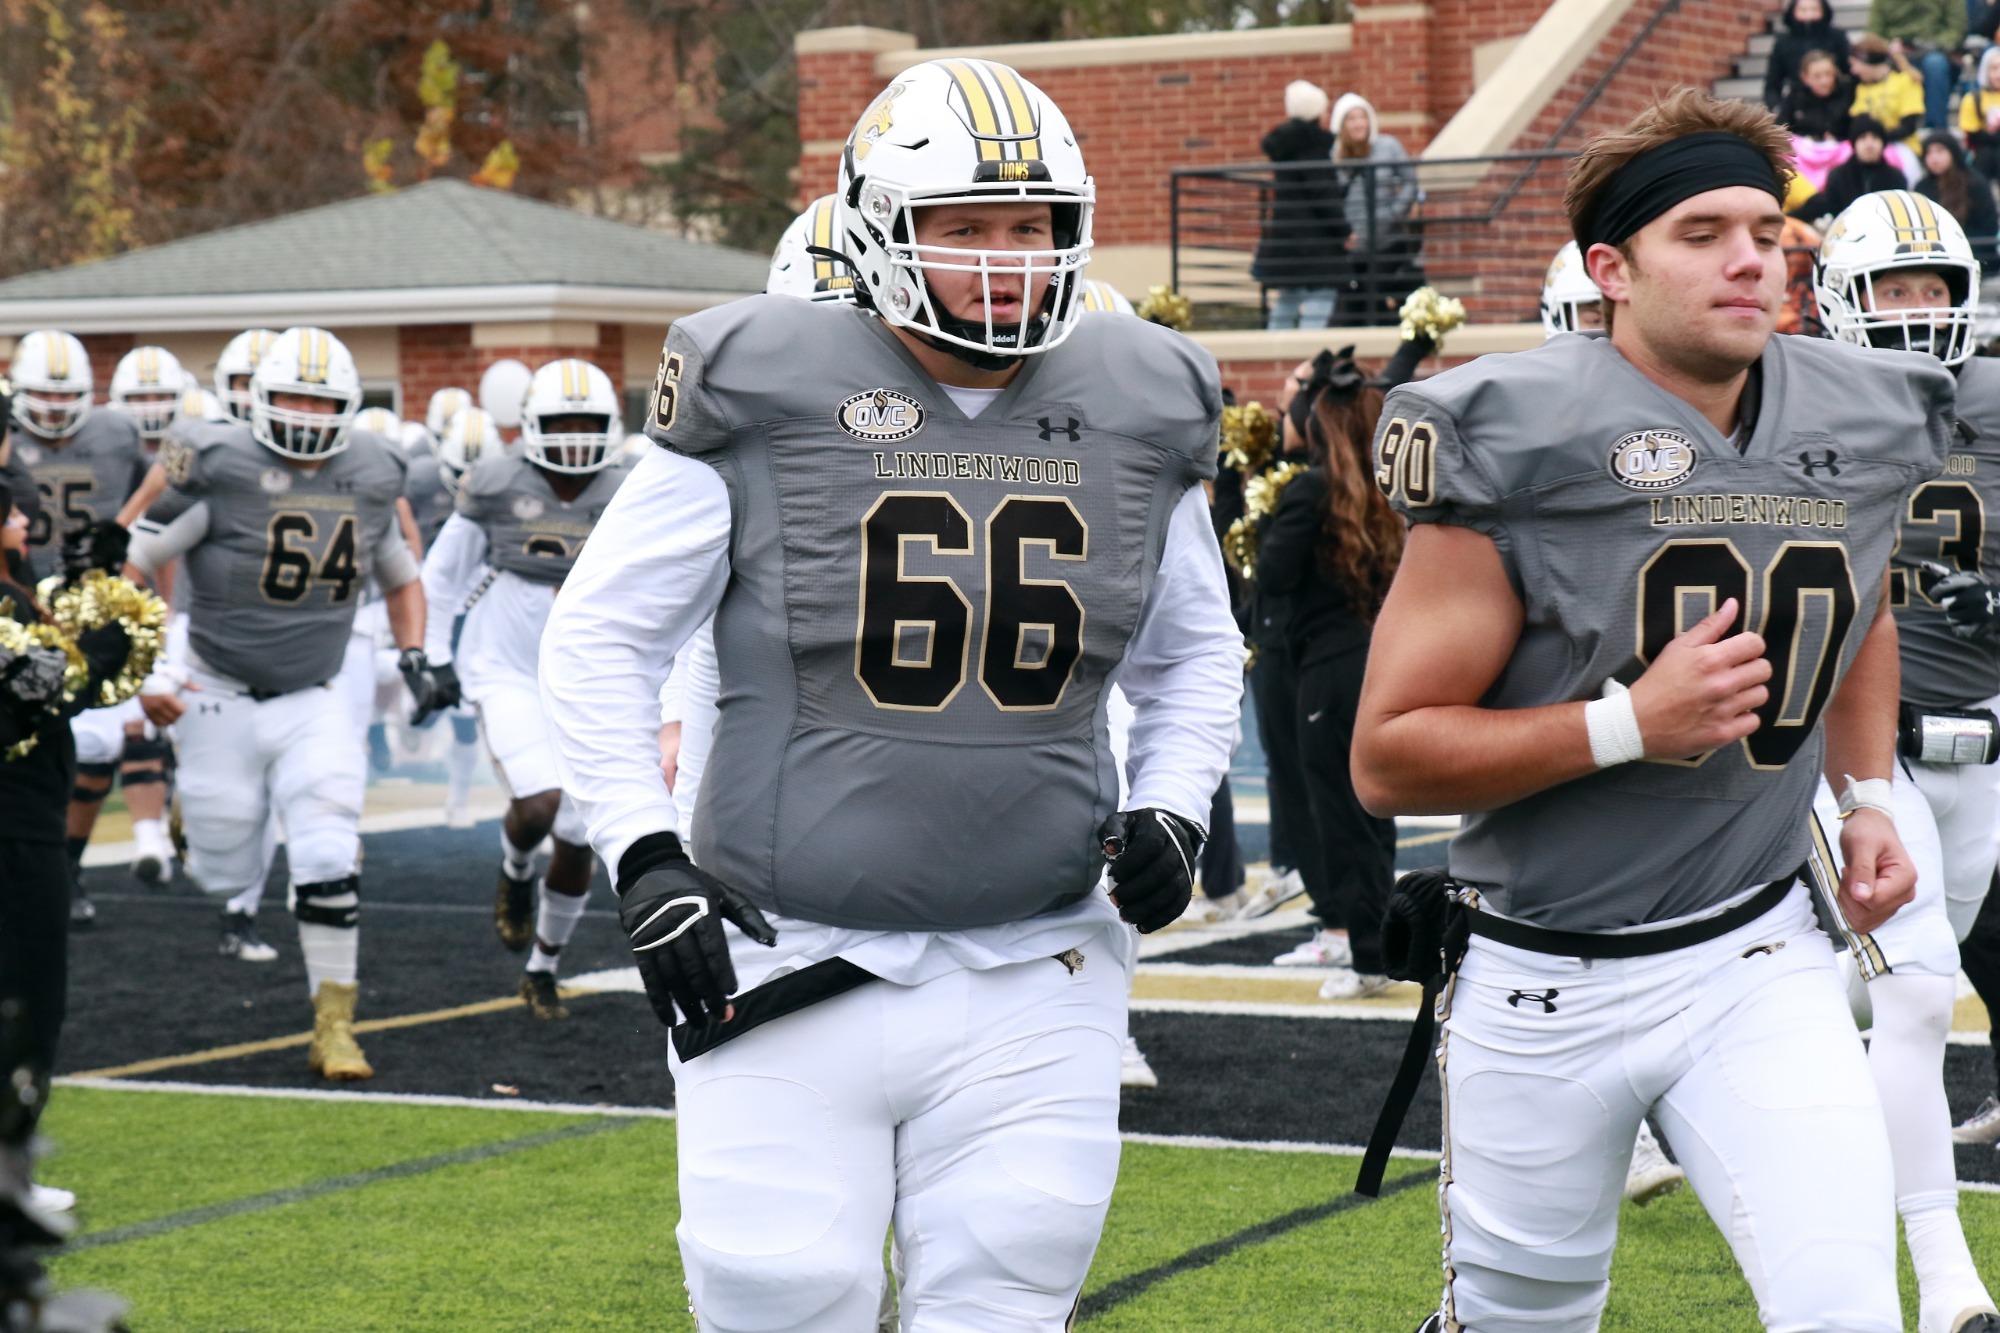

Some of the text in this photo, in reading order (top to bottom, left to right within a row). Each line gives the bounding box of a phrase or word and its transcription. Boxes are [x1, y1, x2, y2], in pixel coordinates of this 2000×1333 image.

[998, 162, 1029, 181] LIONS
[854, 405, 907, 428] OVC
[874, 452, 1081, 486] LINDENWOOD
[1375, 417, 1438, 507] 90
[1650, 494, 1848, 529] LINDENWOOD
[259, 511, 360, 606] 64
[854, 491, 1089, 712] 66
